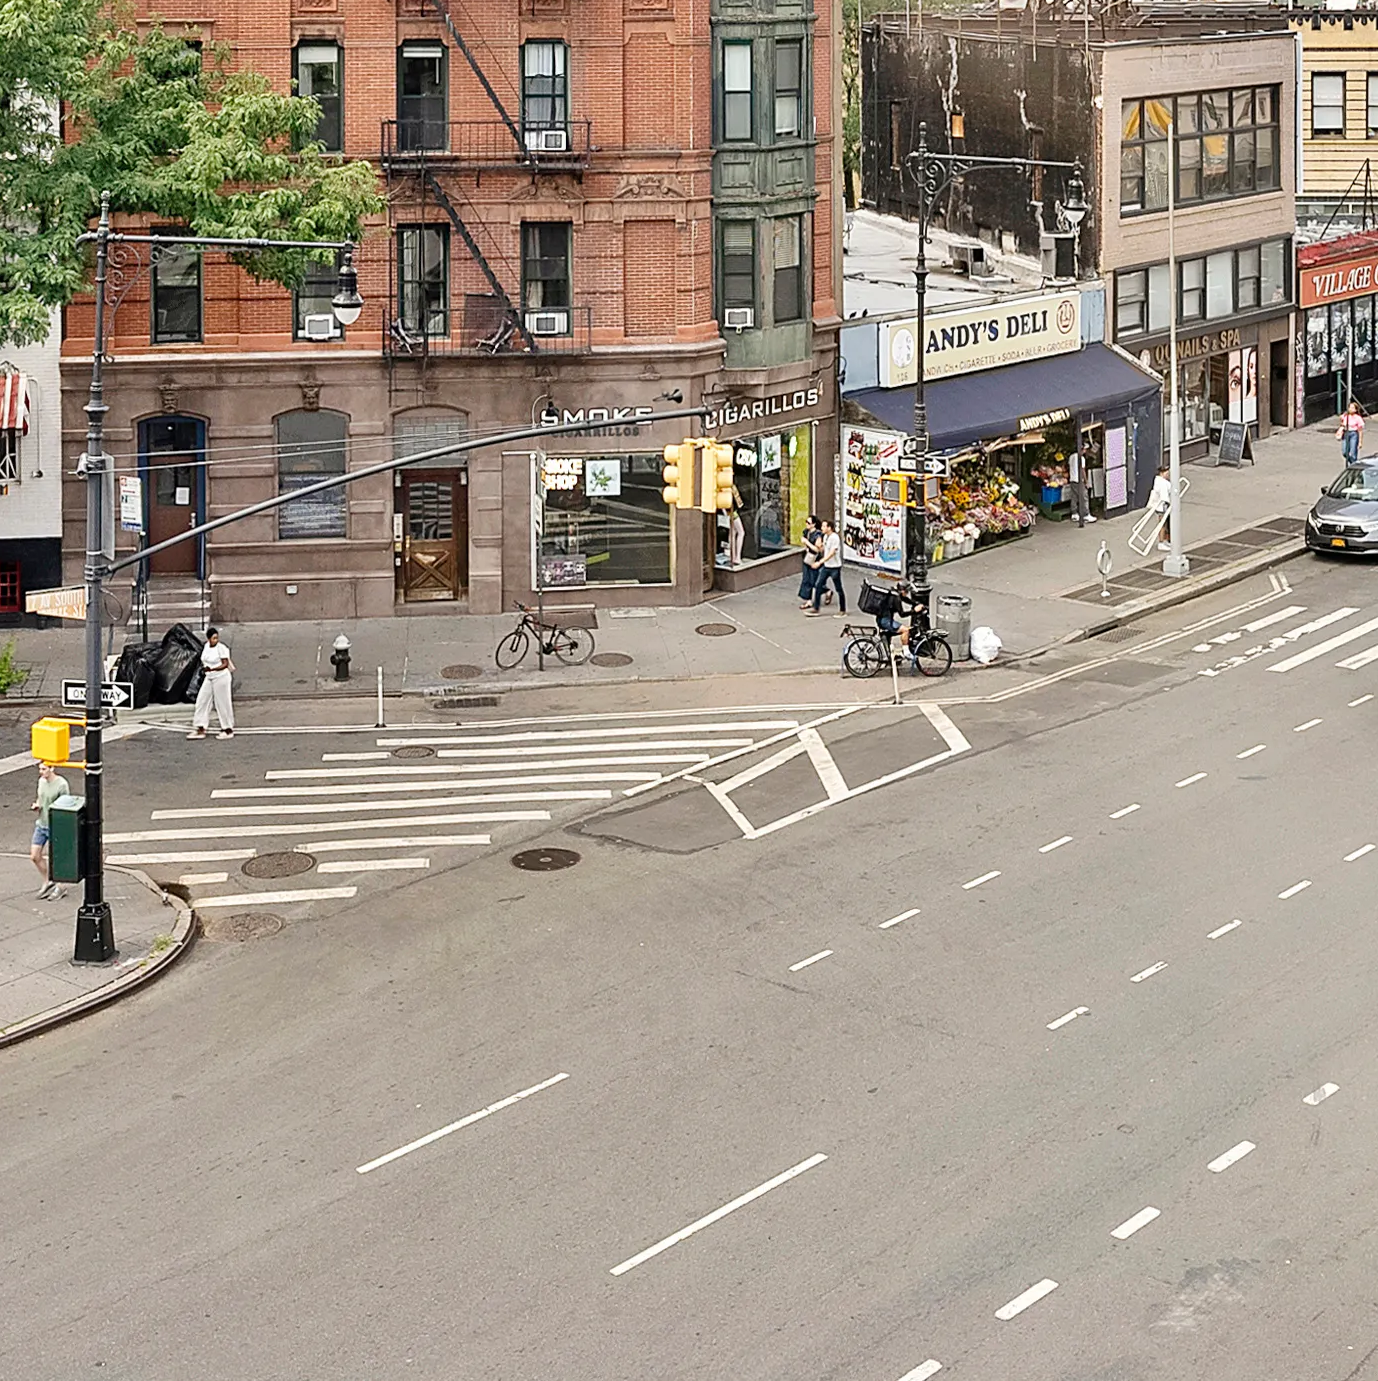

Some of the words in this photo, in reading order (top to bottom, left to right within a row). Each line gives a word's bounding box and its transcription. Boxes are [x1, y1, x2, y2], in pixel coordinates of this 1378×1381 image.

[1313, 265, 1372, 298] VILLAGE
[926, 319, 999, 354] ANDY'S
[1006, 310, 1048, 339] DELI
[1176, 335, 1210, 359] NAILS
[1211, 338, 1218, 351] &
[1220, 328, 1241, 349] SPA
[959, 356, 997, 370] CIGARETTE
[1002, 351, 1021, 363] SODA
[1046, 339, 1078, 353] GROCERY
[541, 406, 653, 428] SMOKE
[705, 387, 819, 430] CIGARILLOS
[55, 588, 84, 607] SOUTH
[73, 688, 87, 699] ON
[102, 690, 122, 701] WAY
